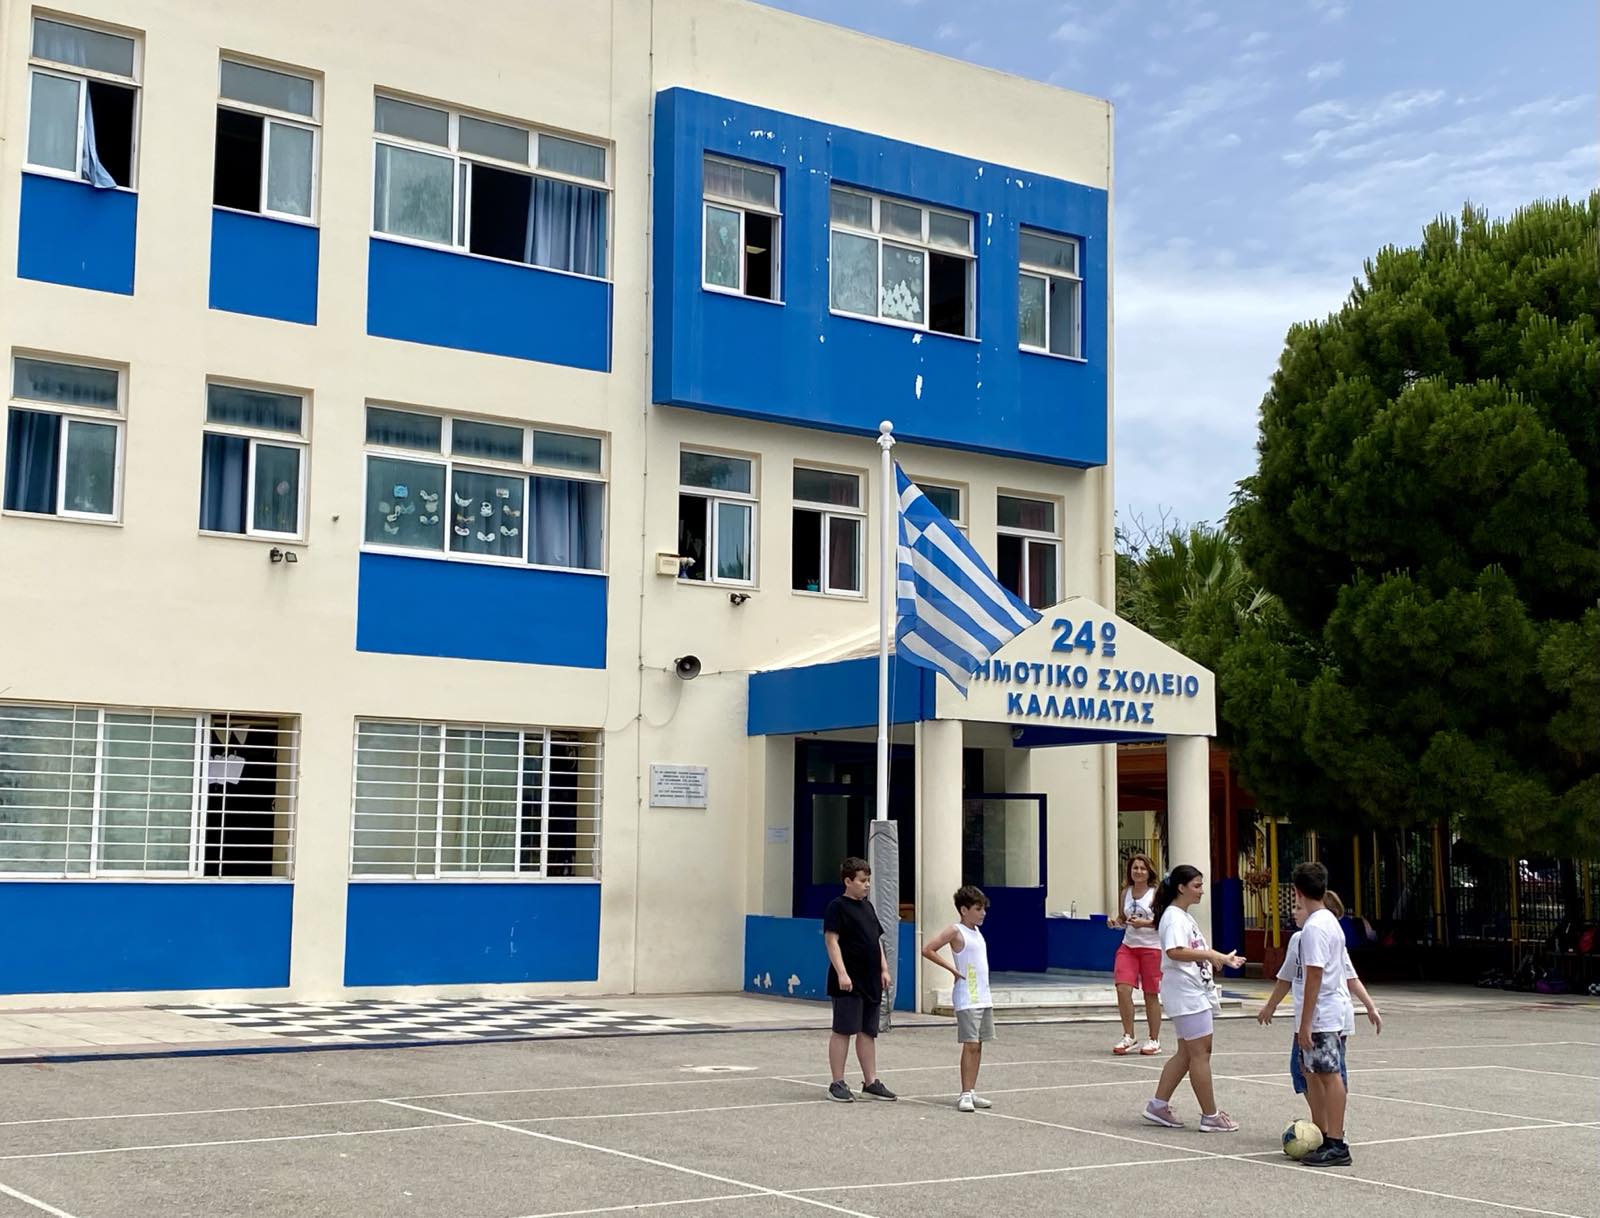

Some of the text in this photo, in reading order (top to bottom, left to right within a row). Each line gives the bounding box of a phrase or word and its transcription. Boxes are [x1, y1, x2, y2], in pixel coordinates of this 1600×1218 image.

[969, 659, 1199, 697] ΗΜΟΤΙΚΟ ΣΧΟΛΕΙΟ
[1007, 692, 1154, 724] ΚΑΛΑΜΑΤΑΣ
